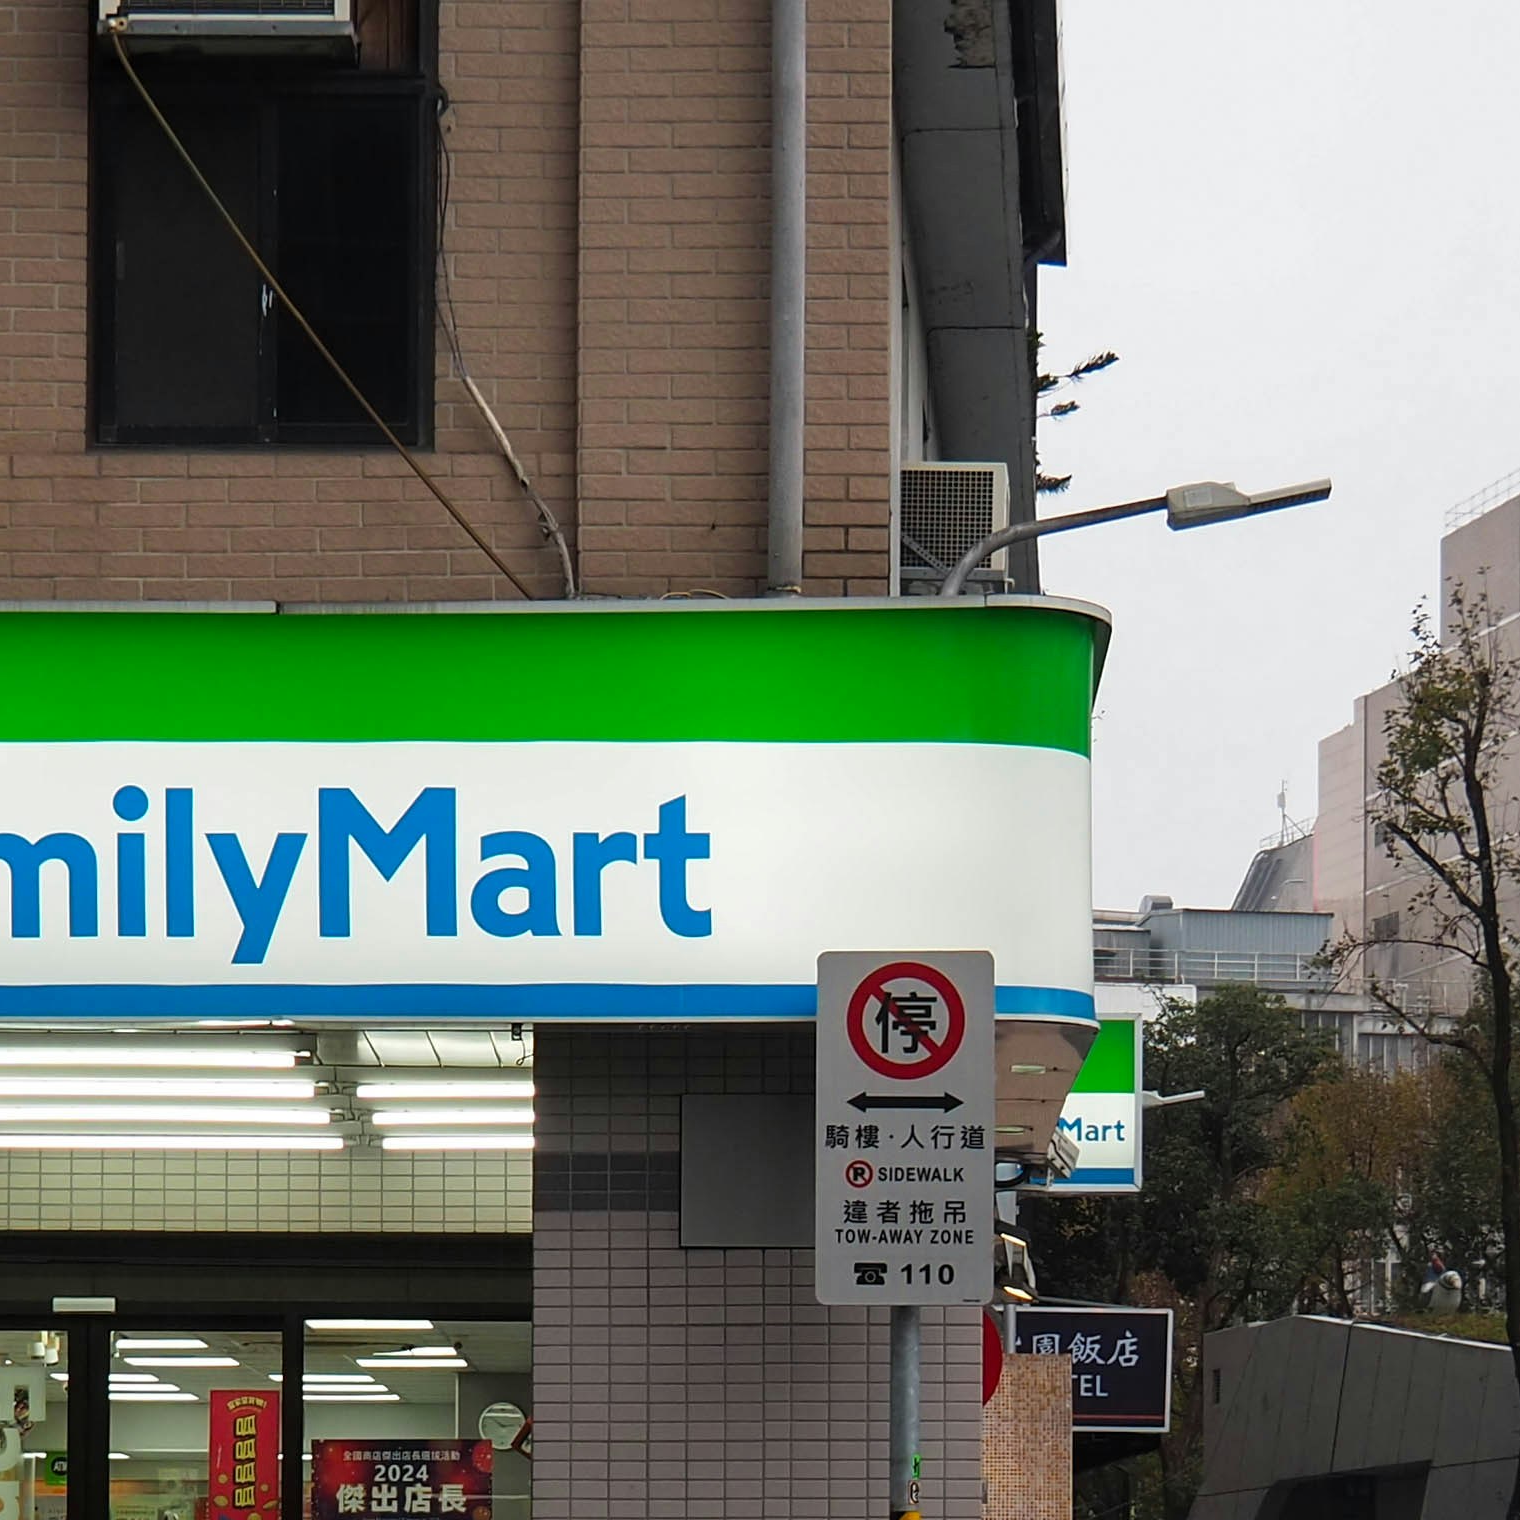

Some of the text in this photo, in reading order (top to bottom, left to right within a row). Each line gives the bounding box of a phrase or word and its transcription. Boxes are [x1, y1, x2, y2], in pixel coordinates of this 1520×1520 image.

[874, 991, 939, 1055] 停
[1057, 1117, 1125, 1142] Mart
[877, 1166, 965, 1183] SIDEWALK
[843, 1199, 967, 1225] 違者拖吊
[834, 1228, 975, 1245] TOW-AWAY ZONE
[900, 1263, 955, 1286] 110
[1015, 1330, 1140, 1368] 園飯店
[374, 1463, 429, 1482] 2024
[335, 1482, 468, 1514] 傑出店長
